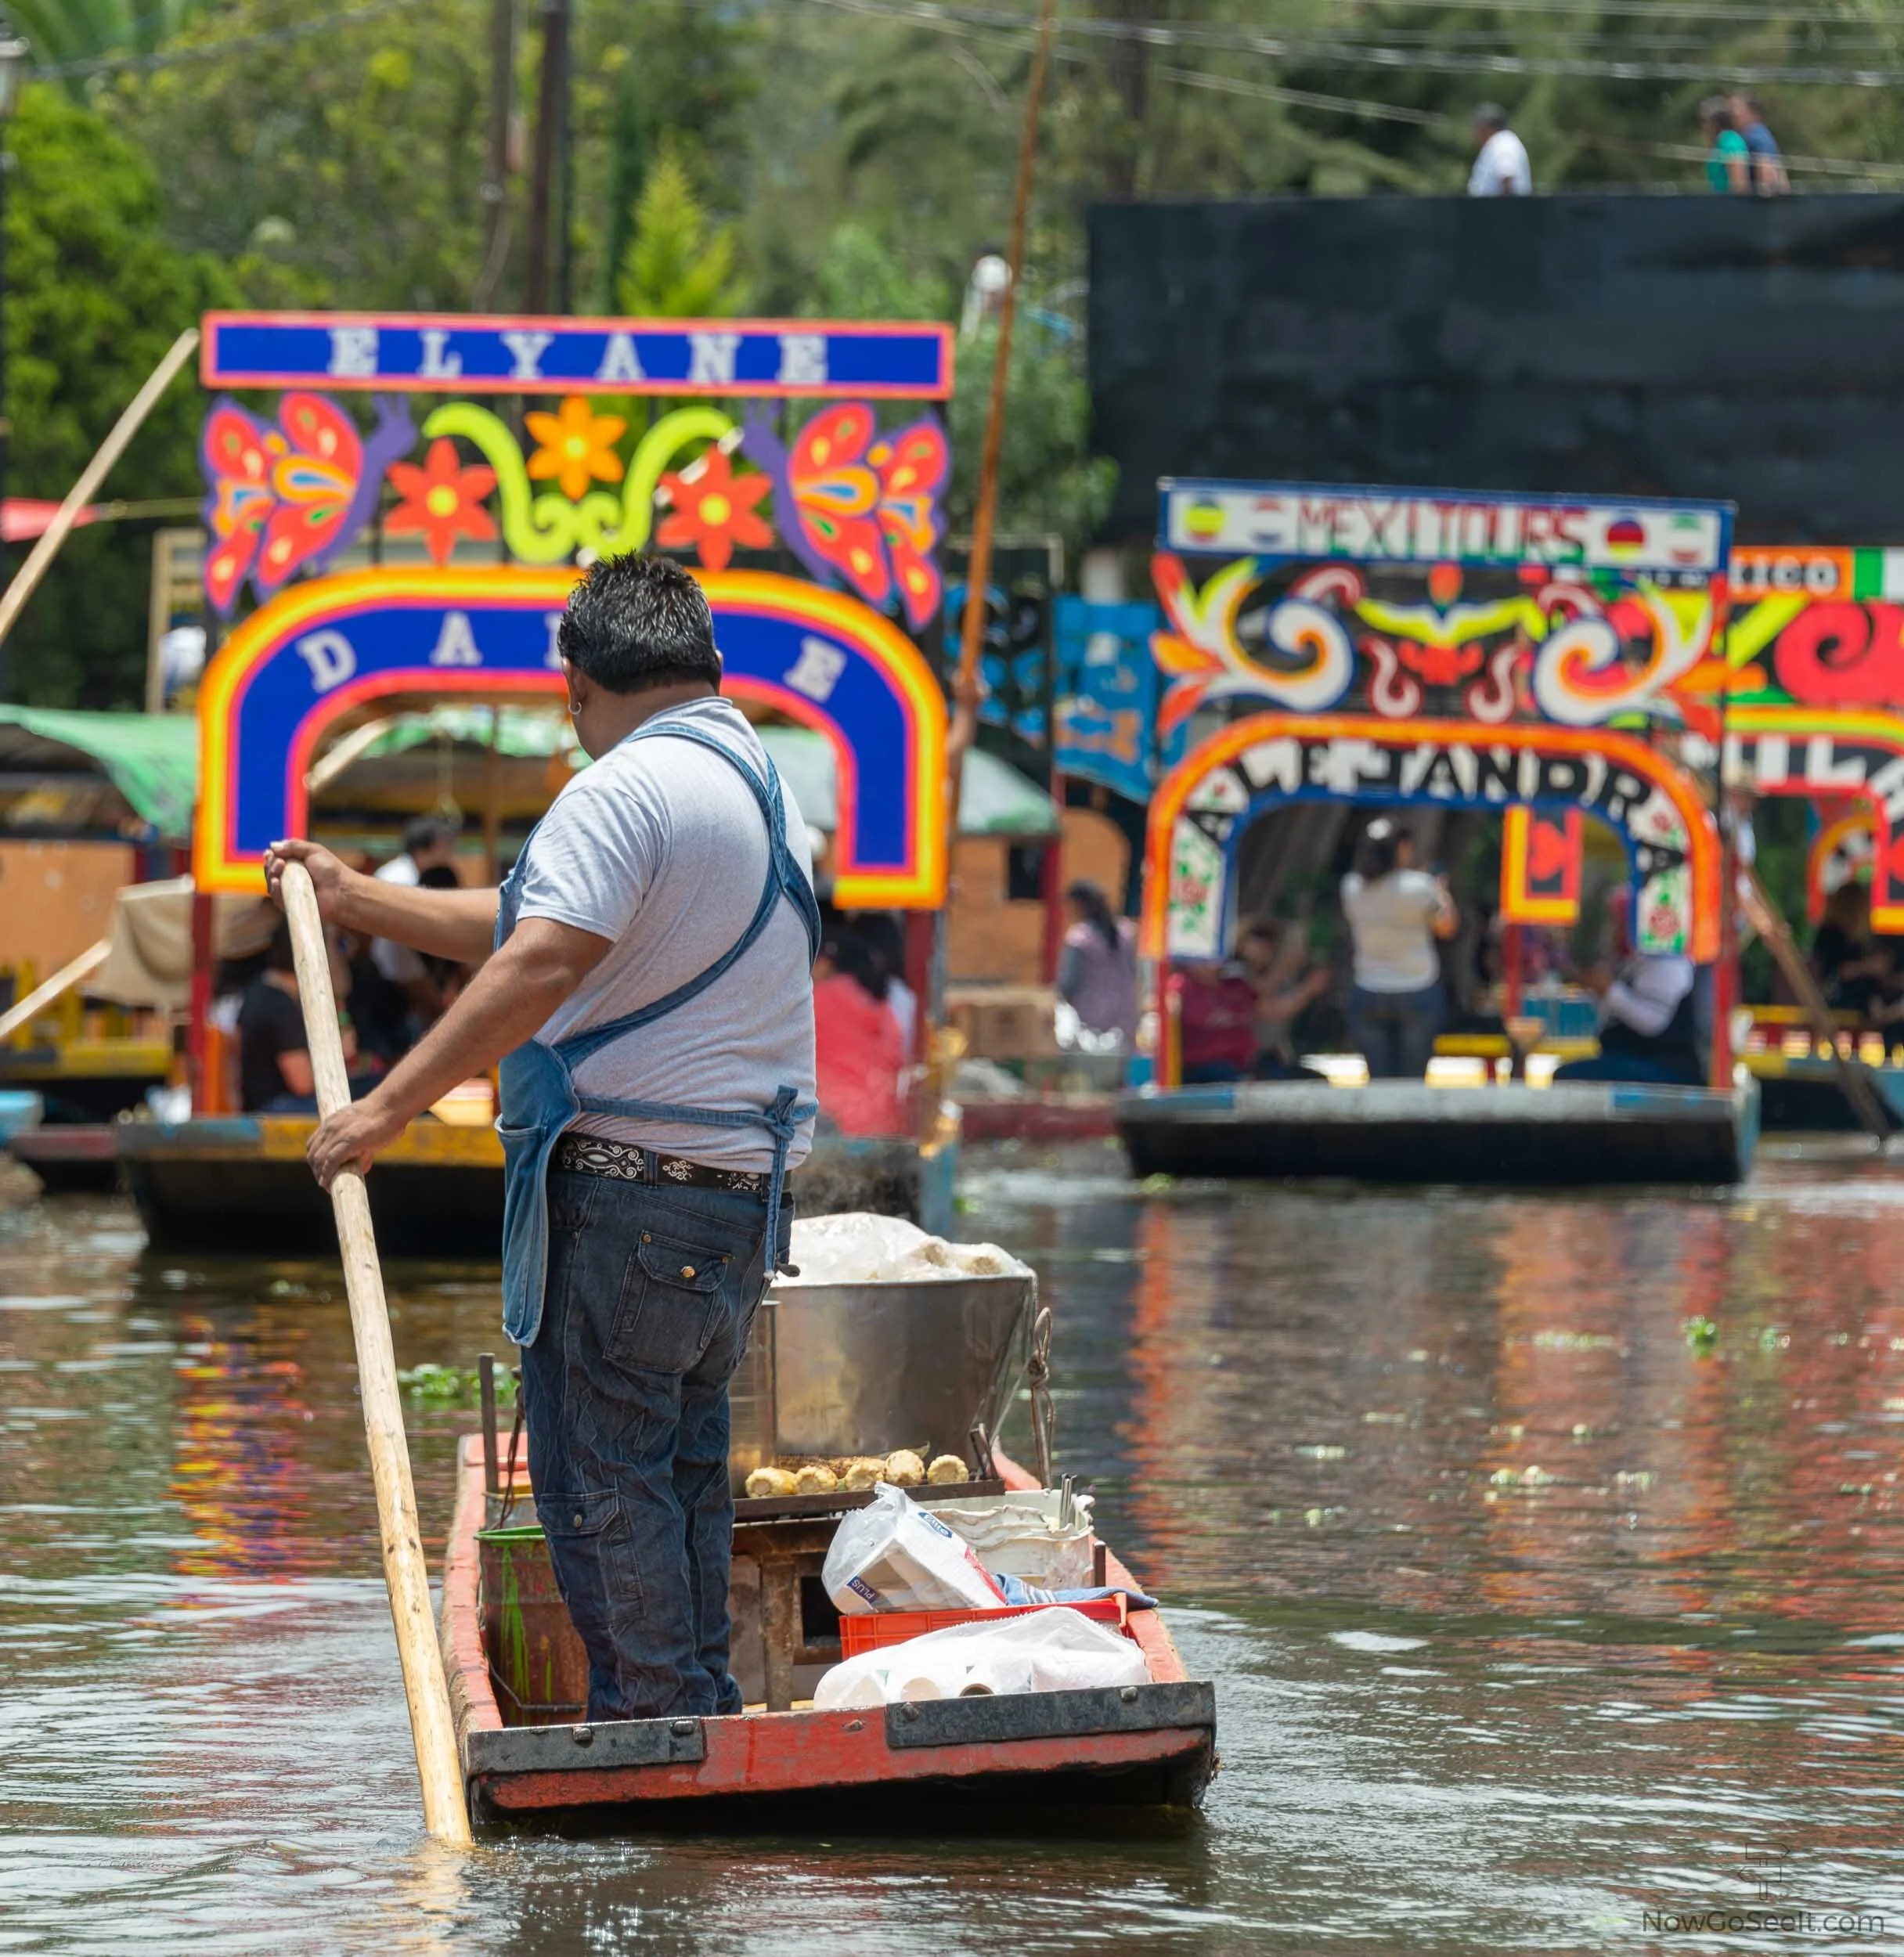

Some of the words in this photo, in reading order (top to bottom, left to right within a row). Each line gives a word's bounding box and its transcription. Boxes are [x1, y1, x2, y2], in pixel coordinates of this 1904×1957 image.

[327, 327, 828, 385] ELYANE
[295, 609, 847, 704] DAE
[852, 1579, 875, 1599] PLUS
